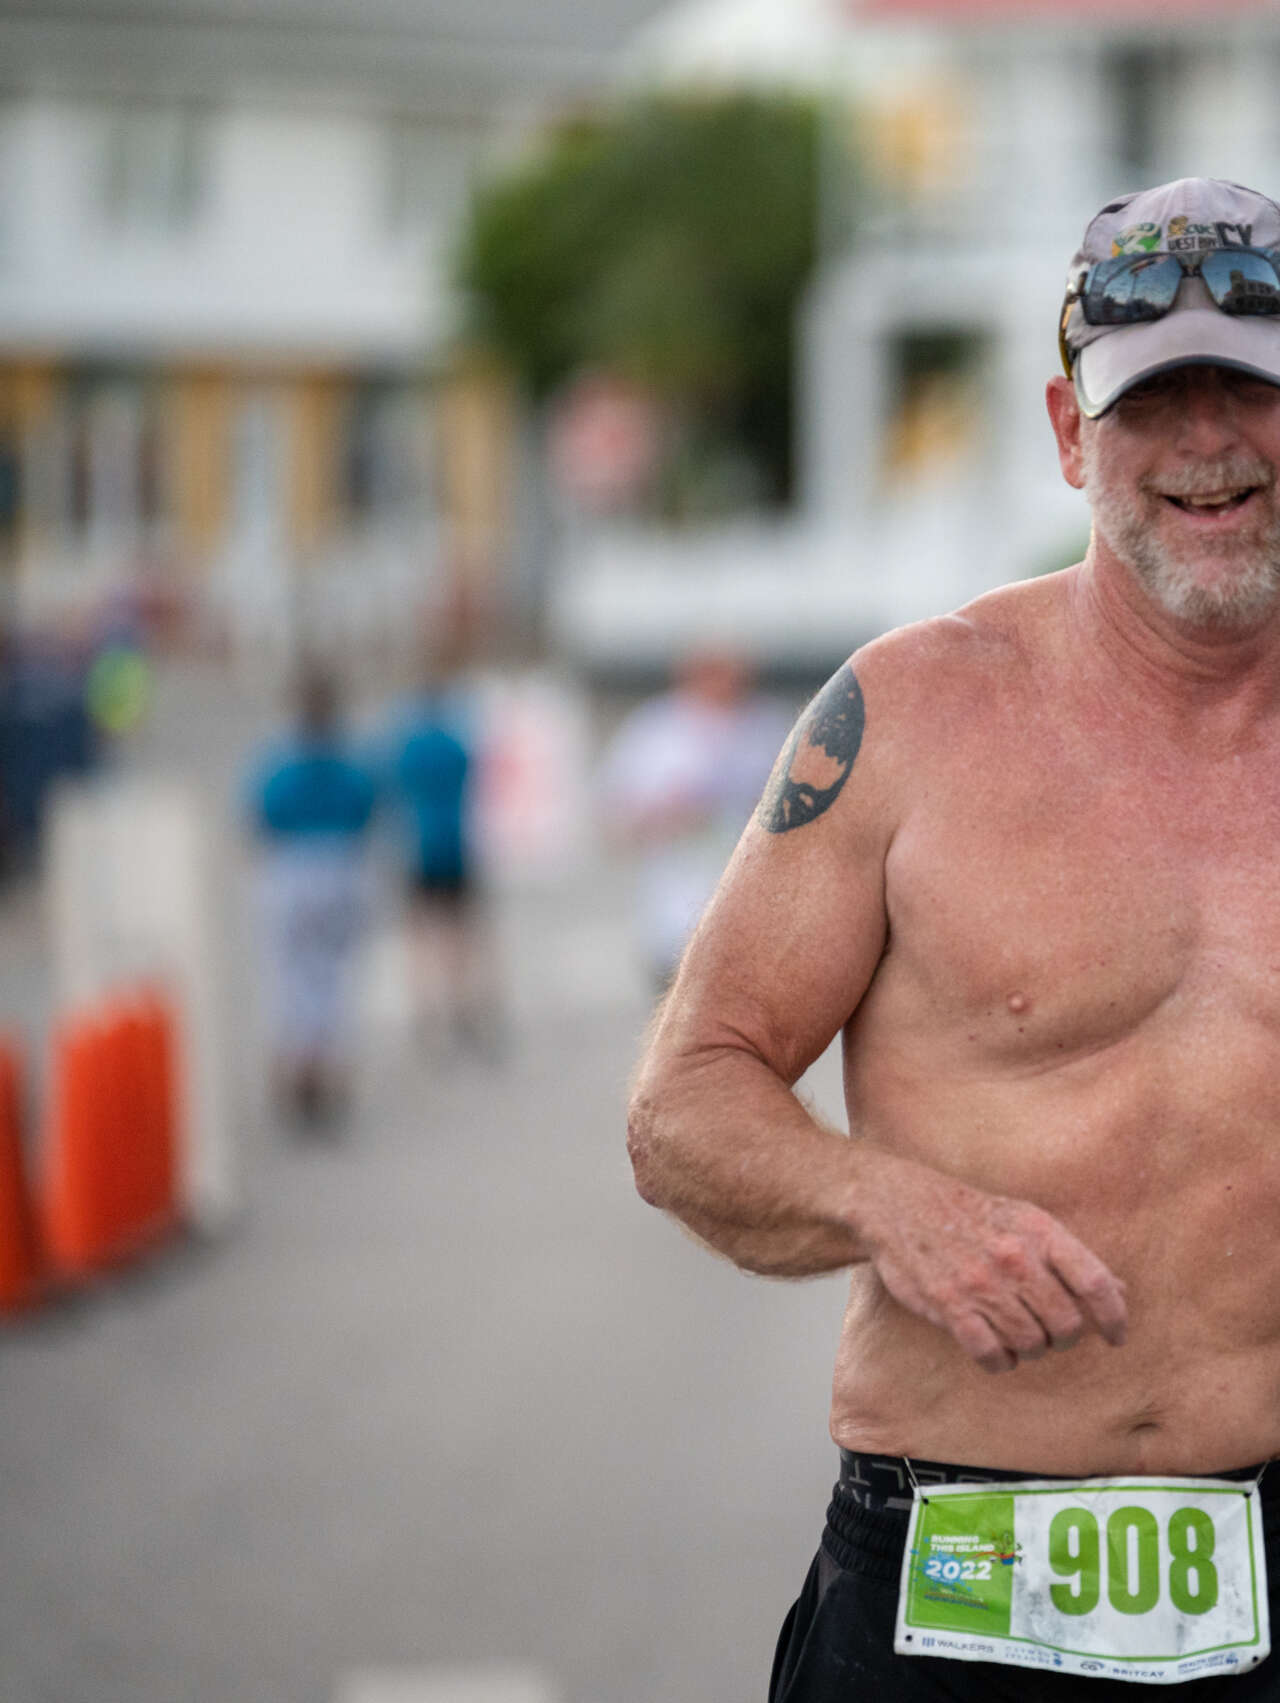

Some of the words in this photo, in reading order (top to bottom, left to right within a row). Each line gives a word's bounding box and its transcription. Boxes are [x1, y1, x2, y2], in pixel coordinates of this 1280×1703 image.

[931, 1535, 979, 1543] RUNNING
[930, 1544, 954, 1552] THIS
[956, 1544, 995, 1552] ISLAND
[1049, 1506, 1218, 1616] 908
[926, 1560, 991, 1580] 2022
[937, 1640, 994, 1653] WALKERS
[1112, 1668, 1164, 1678] BRITCAY
